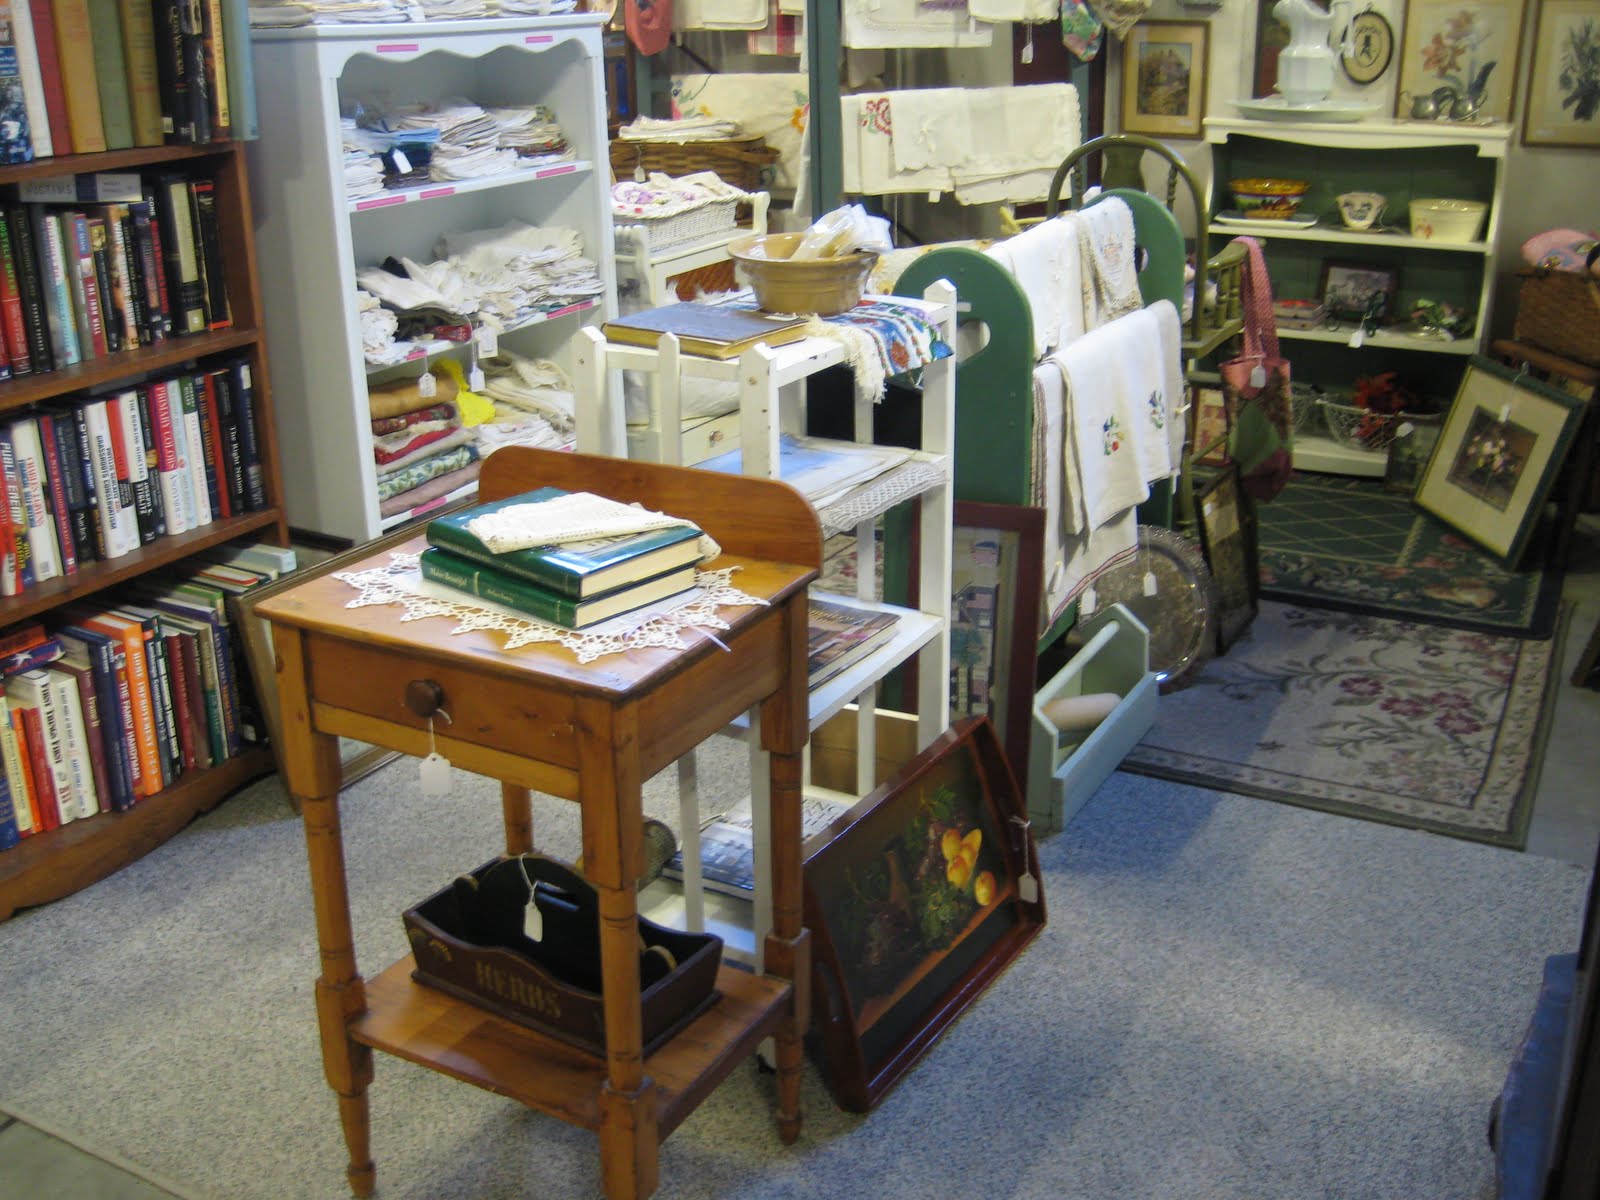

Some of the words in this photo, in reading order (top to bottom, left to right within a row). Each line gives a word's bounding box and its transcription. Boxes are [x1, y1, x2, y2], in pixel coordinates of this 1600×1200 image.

[87, 283, 96, 296] THE
[89, 299, 98, 315] IRON
[92, 318, 102, 336] WALL
[128, 399, 136, 412] THE
[156, 386, 171, 428] PRIMARY
[80, 423, 92, 461] O'Reilly
[131, 414, 141, 445] ROARING
[229, 425, 237, 442] The
[0, 443, 18, 482] PUBLIC
[96, 435, 112, 479] GRASSROOTS
[106, 447, 117, 472] PHYLLIS
[135, 446, 146, 480] NINETIES
[161, 431, 176, 469] COLORS
[231, 443, 242, 465] Right
[235, 466, 244, 494] Nation
[8, 486, 24, 526] ENEMY
[53, 478, 65, 515] RELIGIOUS
[60, 516, 70, 547] AMERICA
[103, 480, 118, 530] CONSERVATISM
[136, 482, 149, 515] STIGLITZ
[133, 651, 143, 678] HOME
[41, 682, 52, 708] FIRST
[120, 680, 129, 699] THE
[147, 641, 158, 678] Landscape
[154, 678, 165, 722] Construction
[88, 695, 100, 719] Frame
[122, 699, 134, 729] FAMILY
[137, 681, 153, 748] IMPROVEMENT
[46, 708, 58, 740] THINGS
[51, 740, 63, 764] FIRST
[126, 730, 141, 780] HANDYMAN
